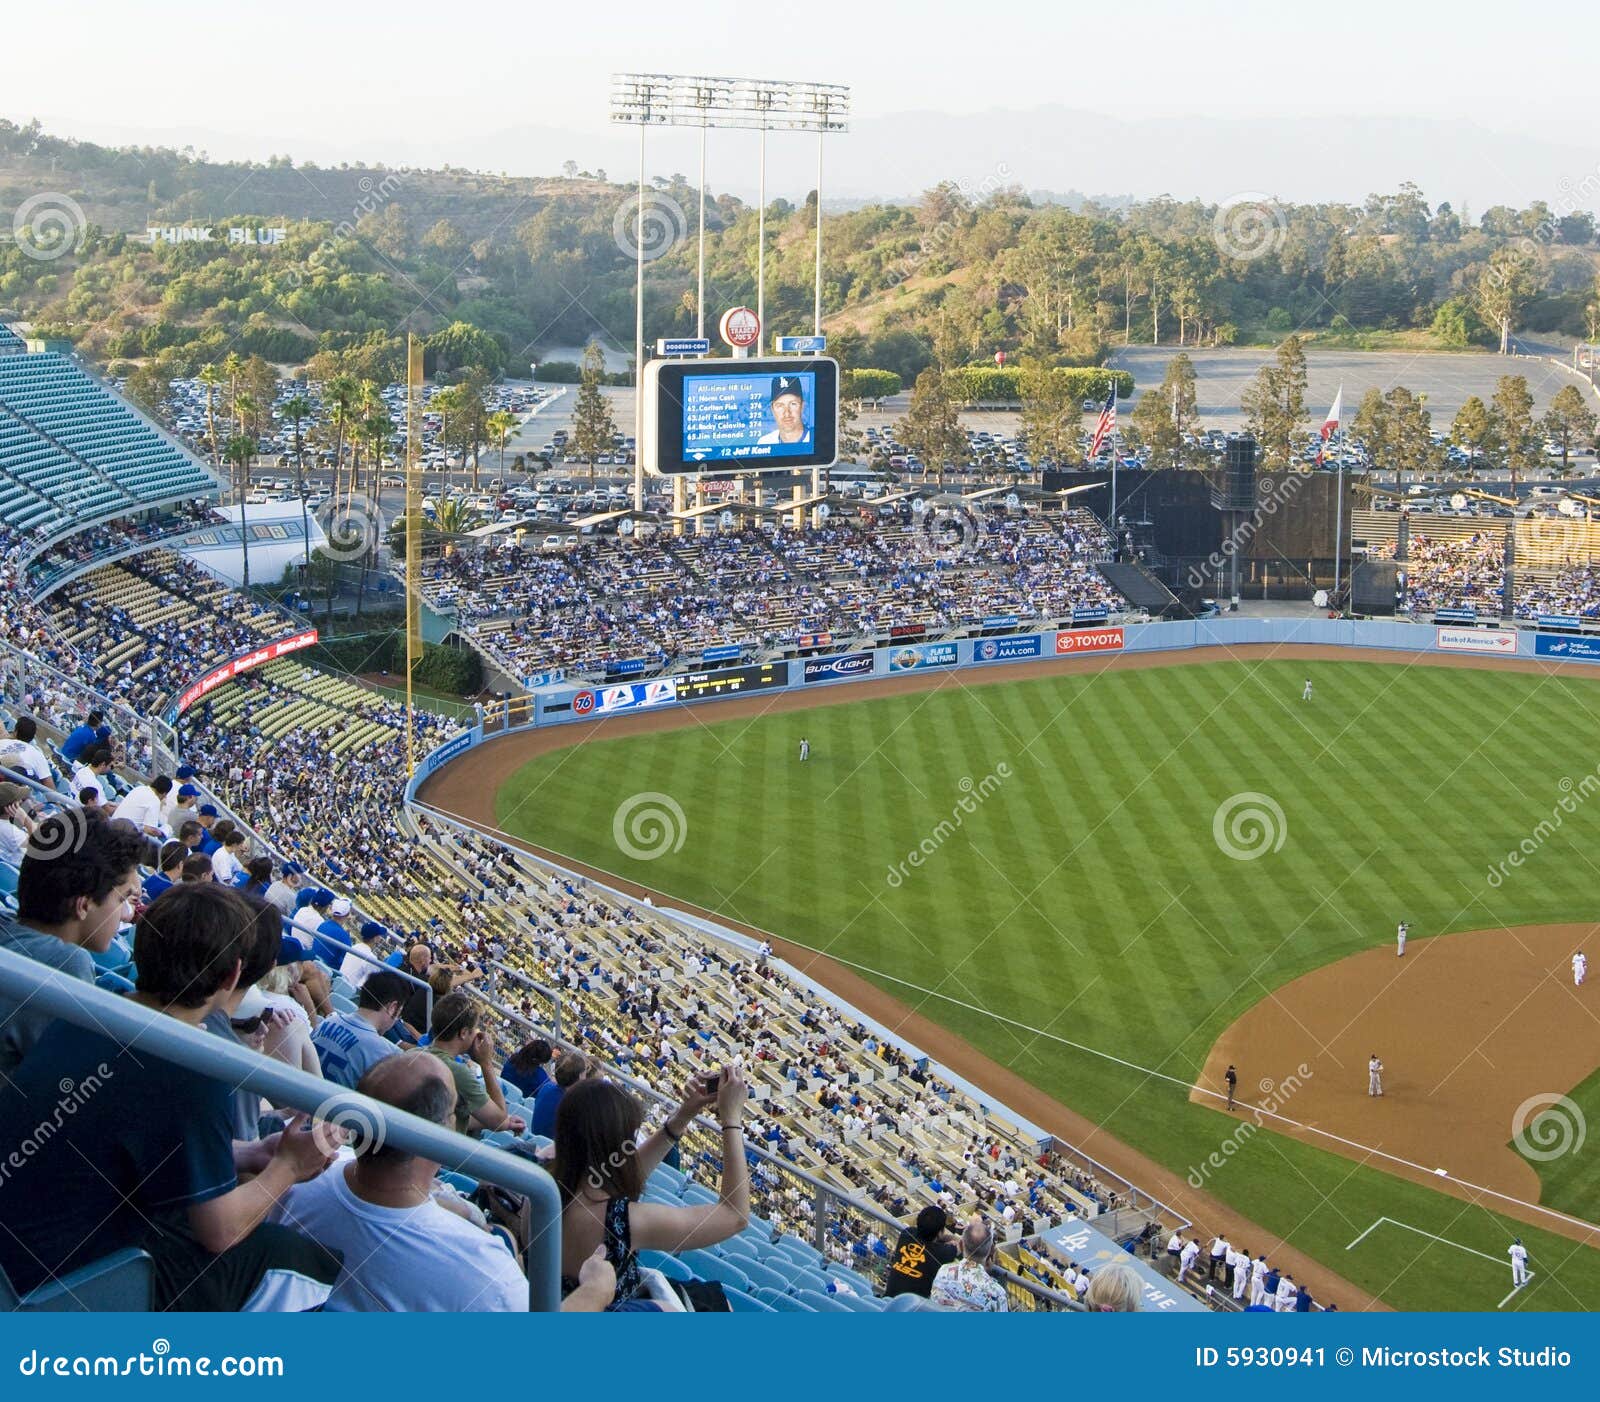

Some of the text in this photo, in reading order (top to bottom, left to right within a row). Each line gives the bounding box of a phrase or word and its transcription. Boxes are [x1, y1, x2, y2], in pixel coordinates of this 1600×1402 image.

[147, 227, 287, 245] THINK BLUE
[721, 448, 731, 456] 12
[733, 447, 750, 456] Jeff
[751, 446, 771, 455] Kent
[1076, 633, 1122, 647] TOYOTA
[1442, 635, 1457, 643] Bank
[1466, 637, 1494, 645] America
[999, 647, 1035, 657] AAA.com
[805, 658, 873, 675] BUD LIGHT
[576, 695, 591, 709] 76
[1143, 1282, 1178, 1310] THE
